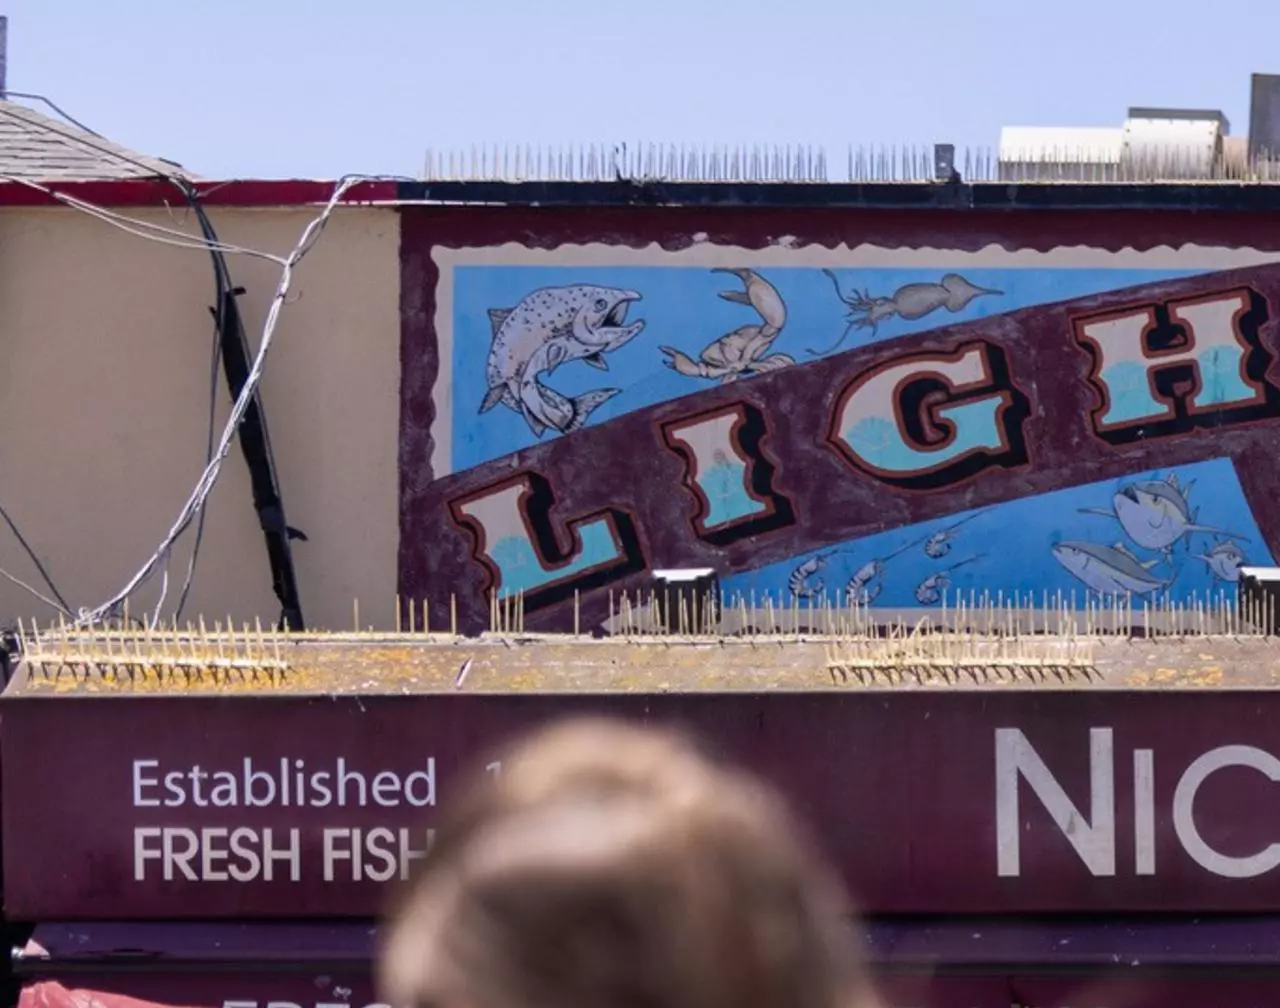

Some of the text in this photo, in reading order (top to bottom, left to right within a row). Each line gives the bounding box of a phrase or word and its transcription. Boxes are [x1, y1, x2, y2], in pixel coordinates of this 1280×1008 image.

[132, 756, 437, 808] Established
[134, 826, 436, 882] FRESH FISH
